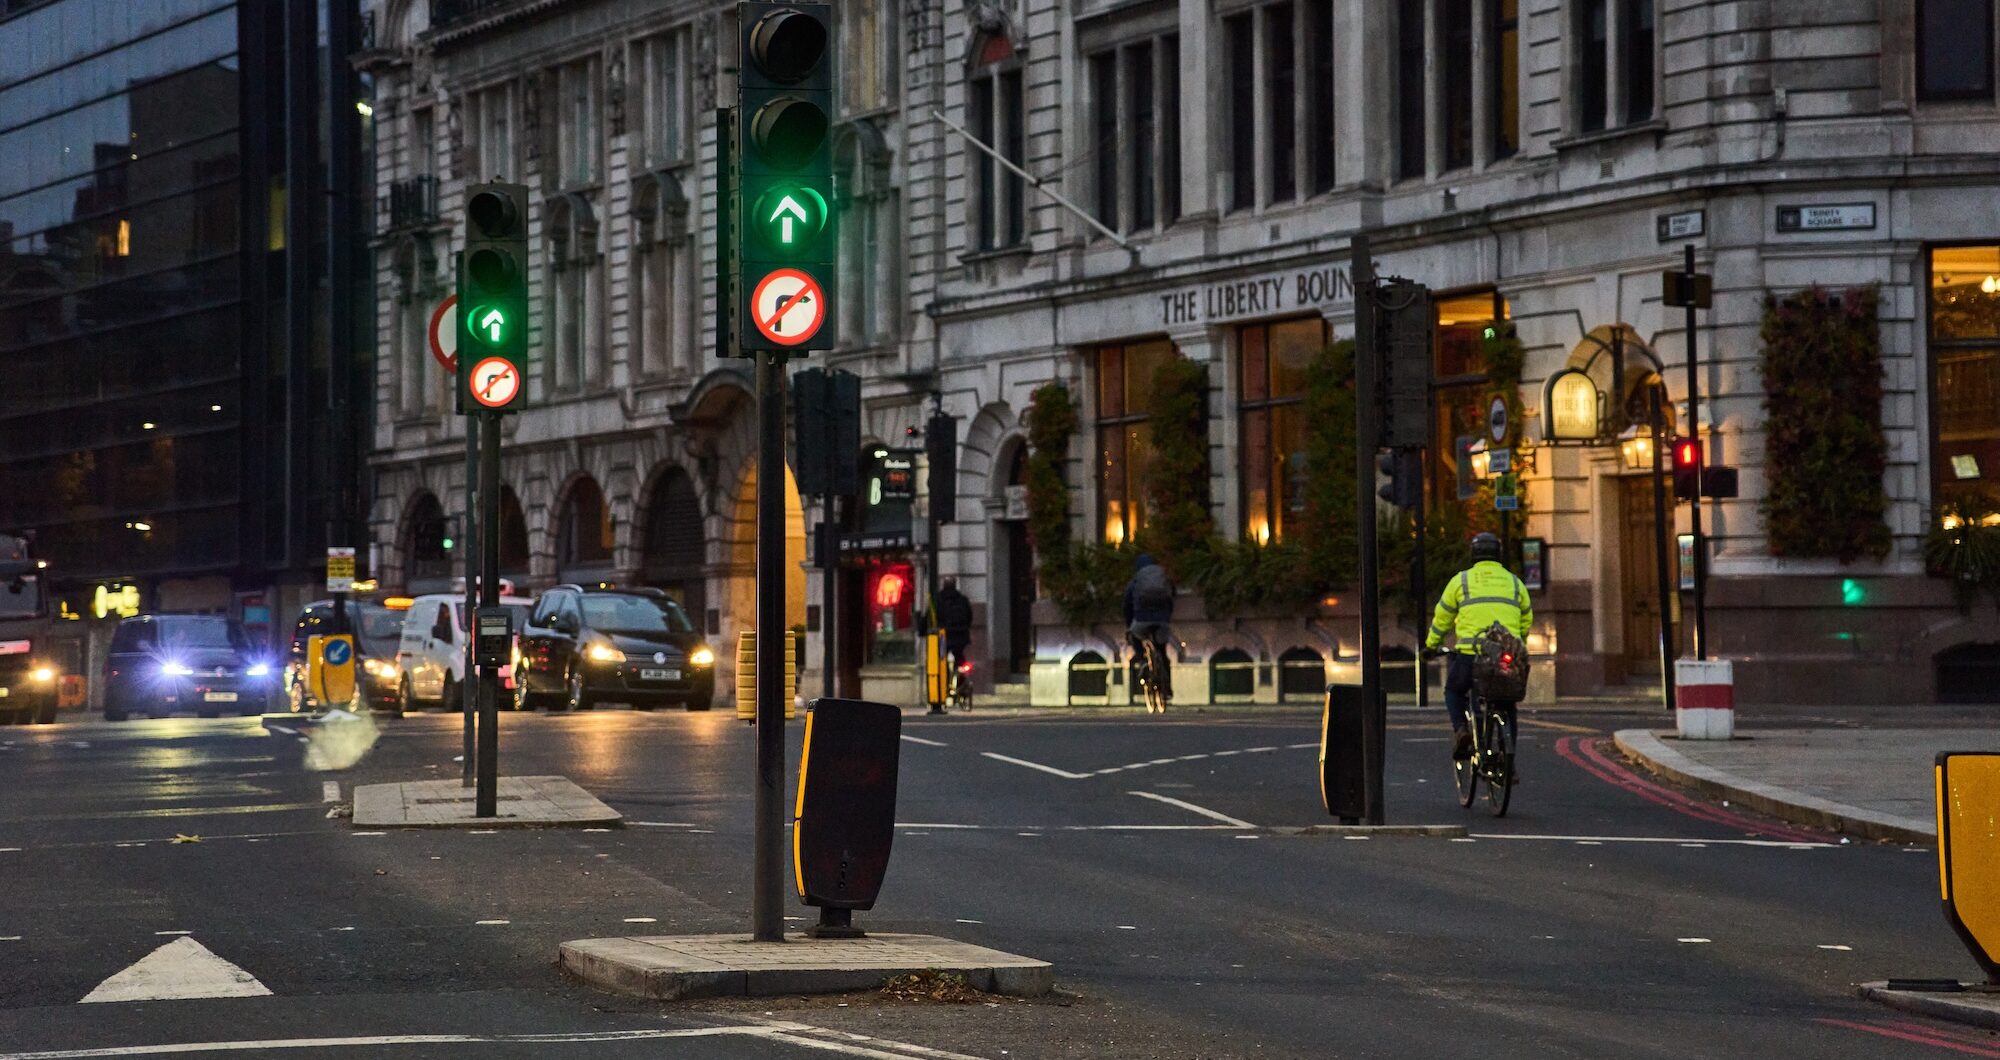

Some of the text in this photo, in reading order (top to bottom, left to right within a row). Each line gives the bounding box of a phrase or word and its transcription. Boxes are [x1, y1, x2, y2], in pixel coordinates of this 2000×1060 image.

[1807, 217, 1843, 226] SQUARE
[1160, 290, 1197, 324] THE
[1207, 276, 1285, 319] LIBERTY
